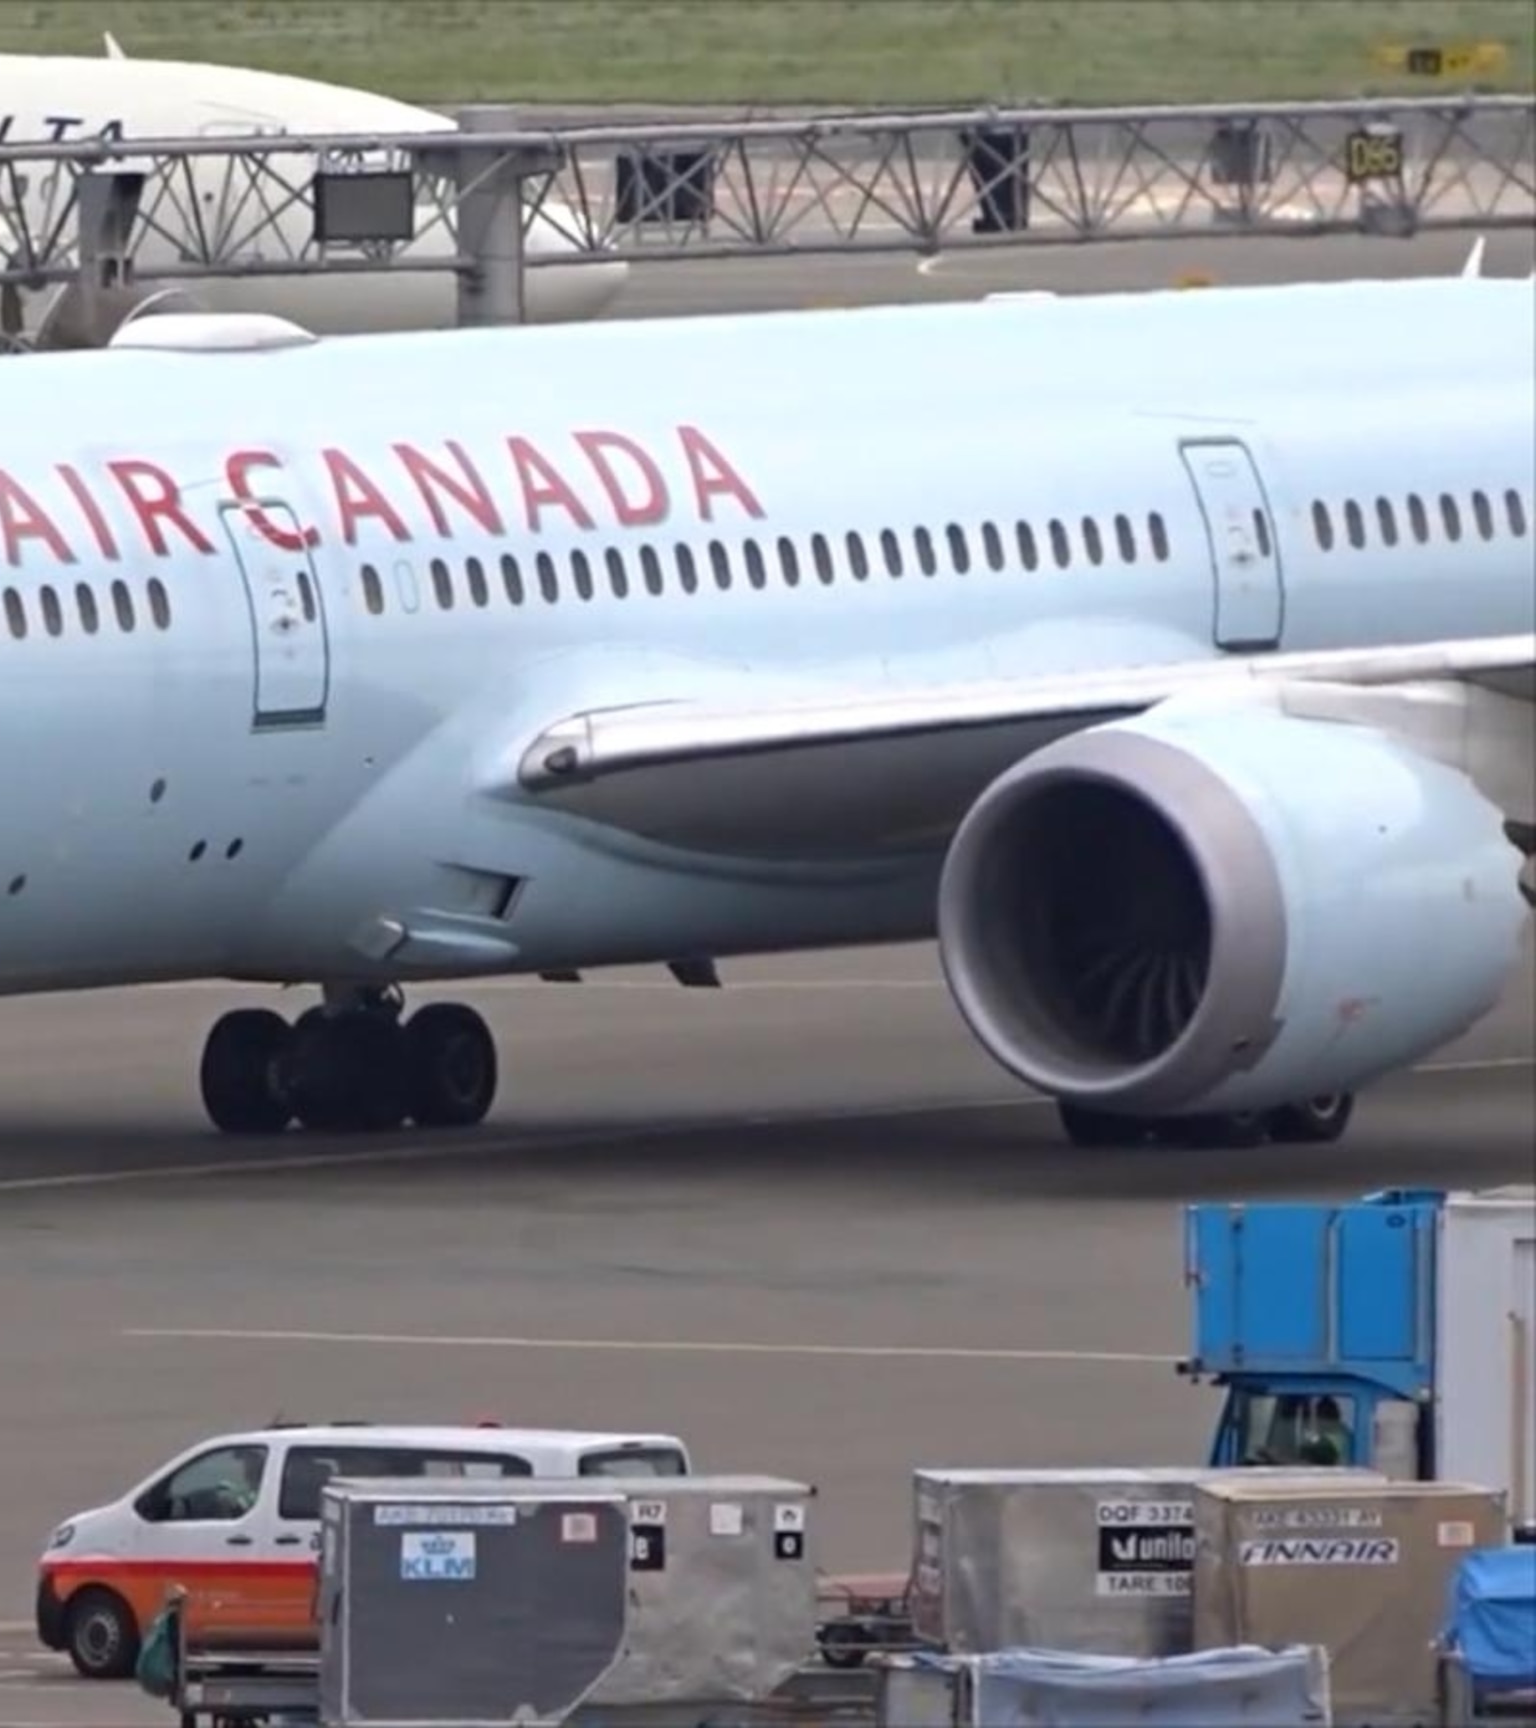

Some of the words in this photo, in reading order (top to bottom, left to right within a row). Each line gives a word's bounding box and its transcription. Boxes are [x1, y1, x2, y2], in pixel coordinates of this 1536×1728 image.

[225, 425, 768, 554] CANADA
[1098, 1505, 1140, 1522] DQF
[1243, 1540, 1395, 1562] FINNAIR
[402, 1557, 474, 1576] KLM
[1107, 1576, 1156, 1591] TARE
